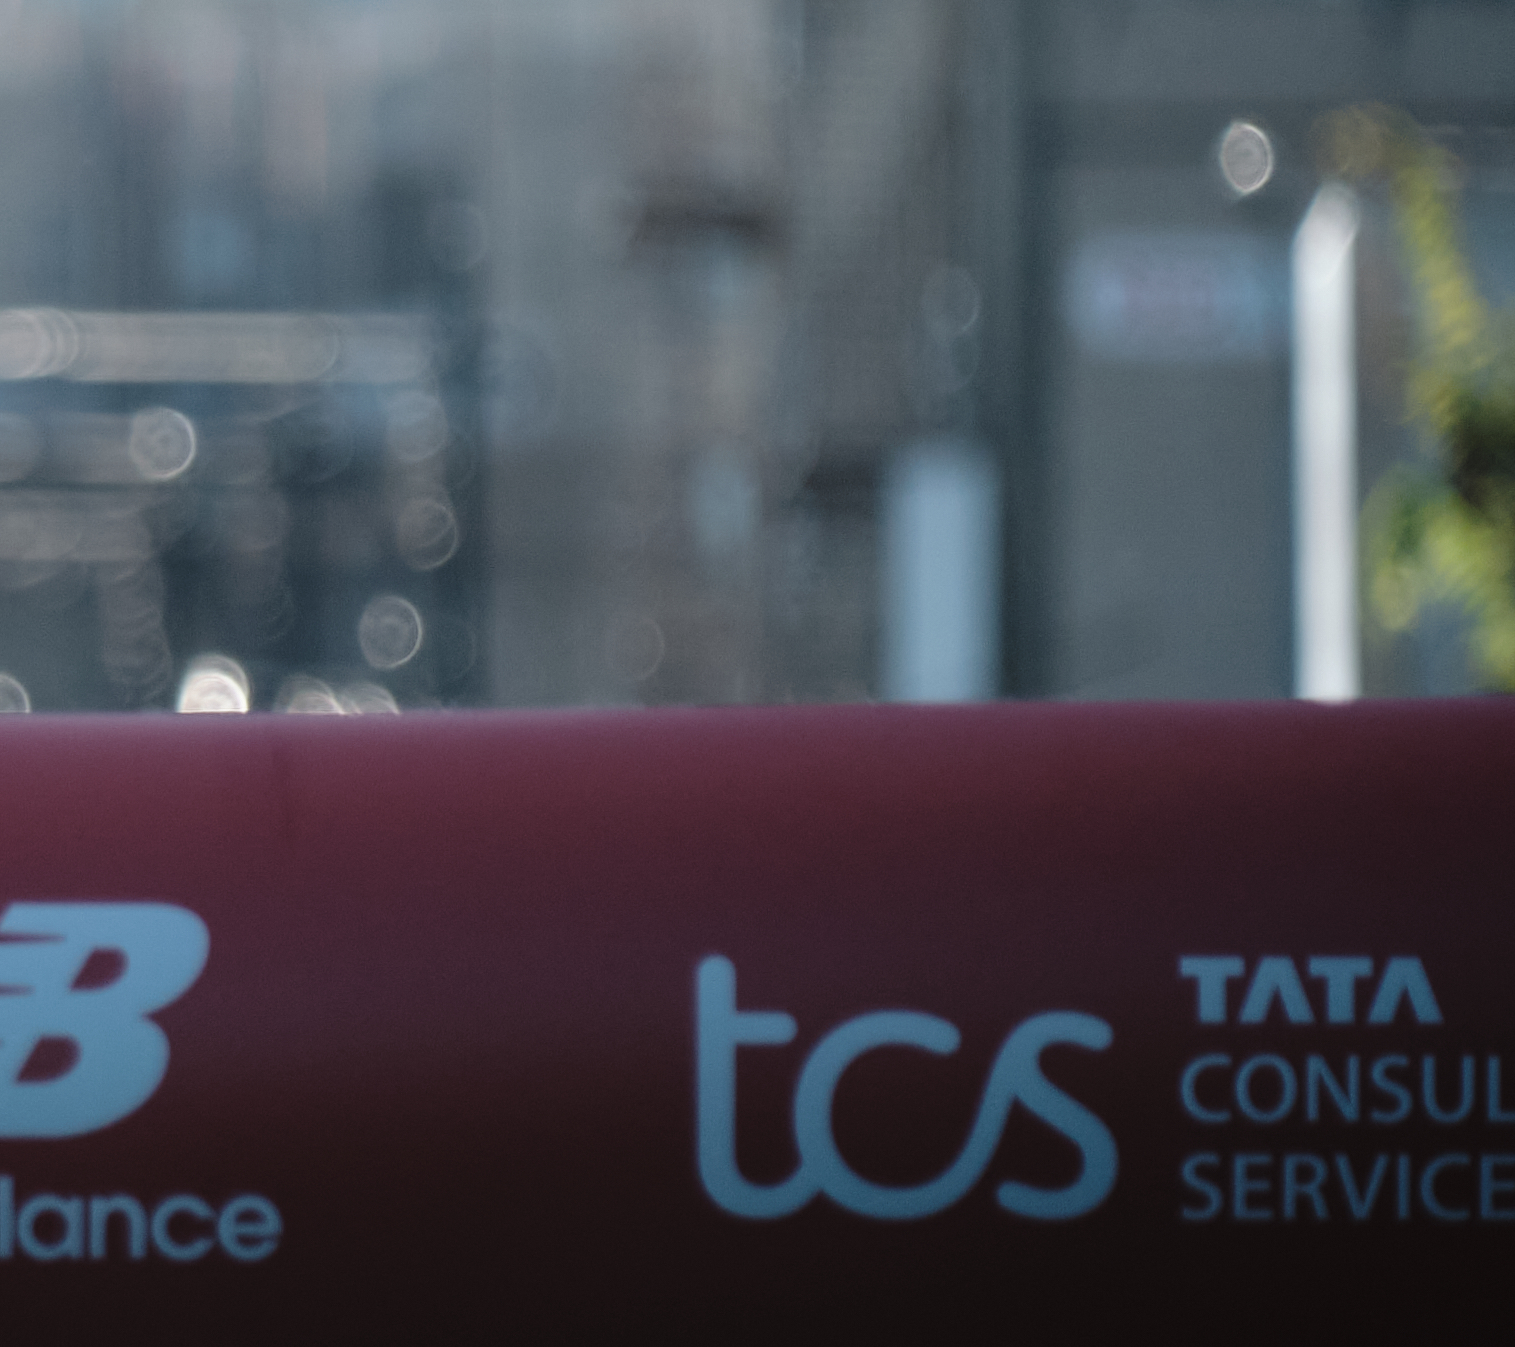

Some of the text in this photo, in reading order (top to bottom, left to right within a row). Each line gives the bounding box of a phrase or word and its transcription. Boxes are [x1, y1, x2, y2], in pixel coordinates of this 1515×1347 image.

[1179, 955, 1443, 1025] TATA
[694, 953, 1121, 1221] tcs
[1179, 1053, 1515, 1124] CONSUL
[1179, 1151, 1515, 1222] SERVICE
